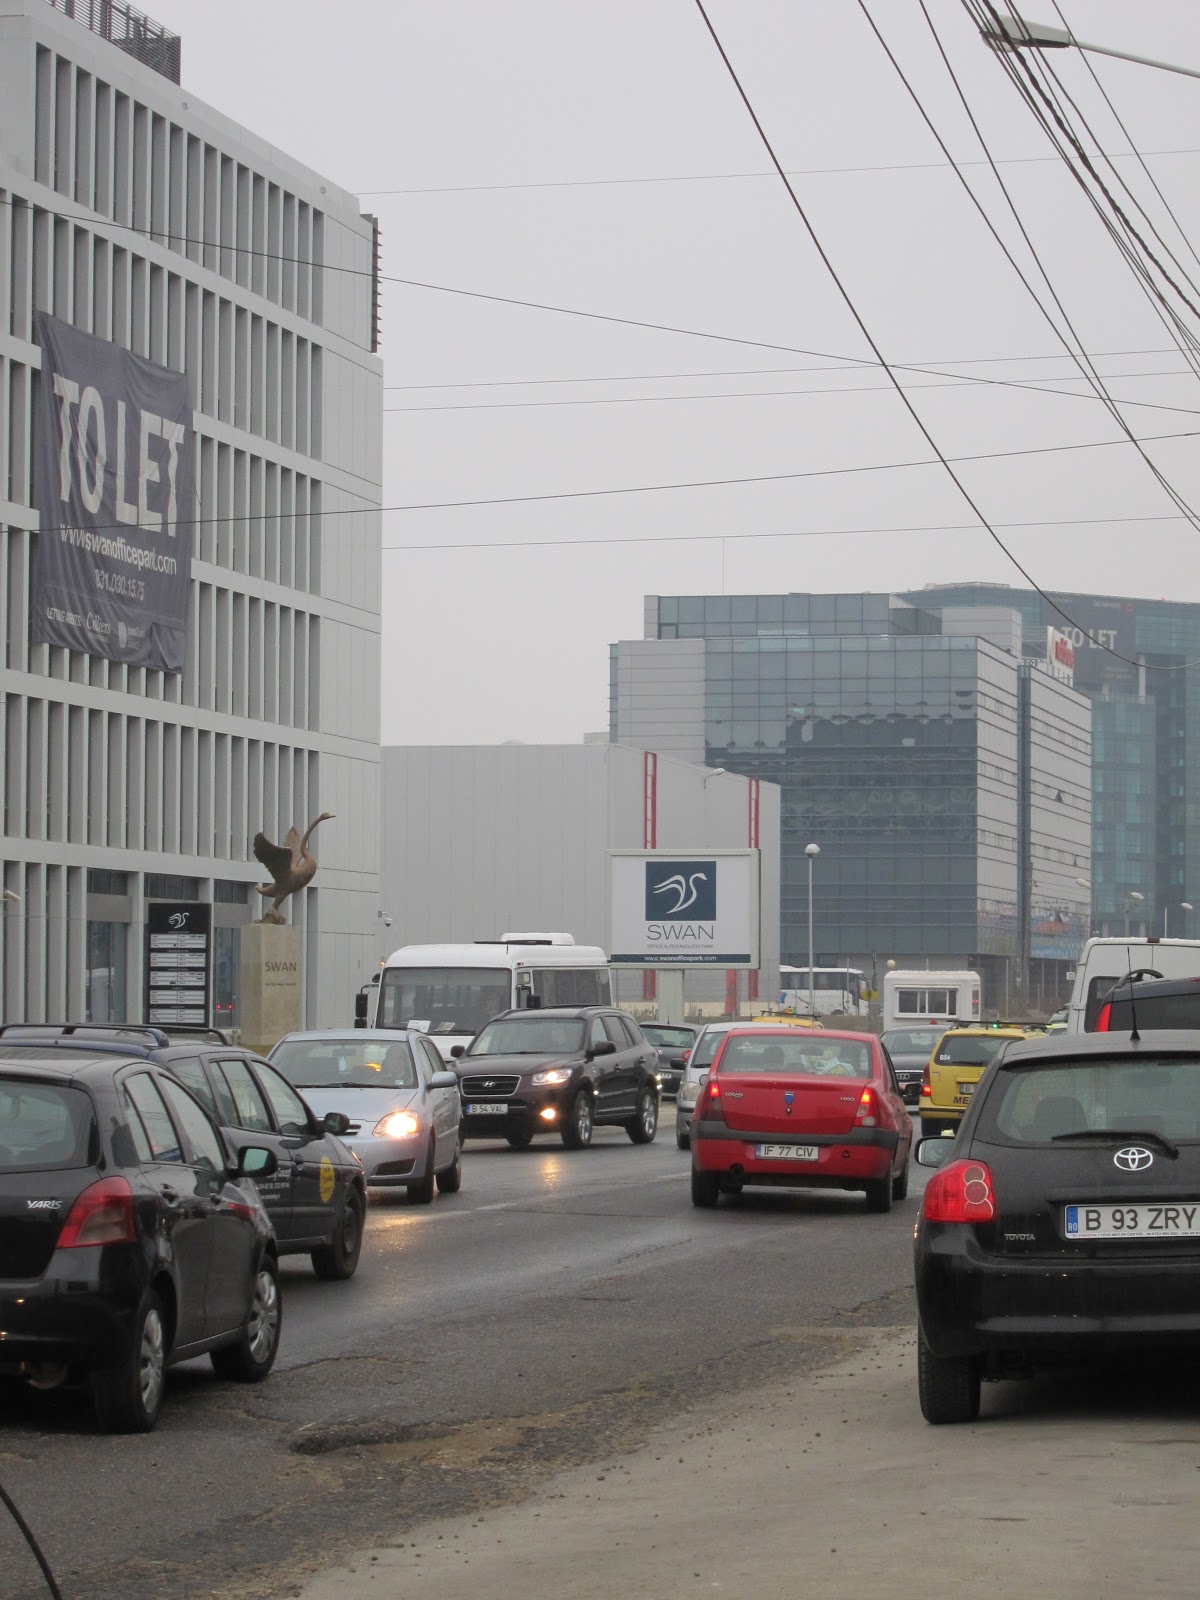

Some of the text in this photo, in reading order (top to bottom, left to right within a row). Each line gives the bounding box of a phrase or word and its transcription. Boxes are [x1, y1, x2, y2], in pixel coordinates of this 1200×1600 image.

[53, 373, 185, 537] TO LET
[1089, 629, 1117, 650] LET
[647, 924, 714, 941] SWAN
[265, 961, 297, 972] SWAN
[472, 1105, 477, 1113] B
[764, 1145, 814, 1158] IF 77 CIV
[1085, 1207, 1197, 1231] B 93 ZRY
[1067, 1222, 1078, 1232] RO
[1004, 1233, 1036, 1241] TOYOTA
